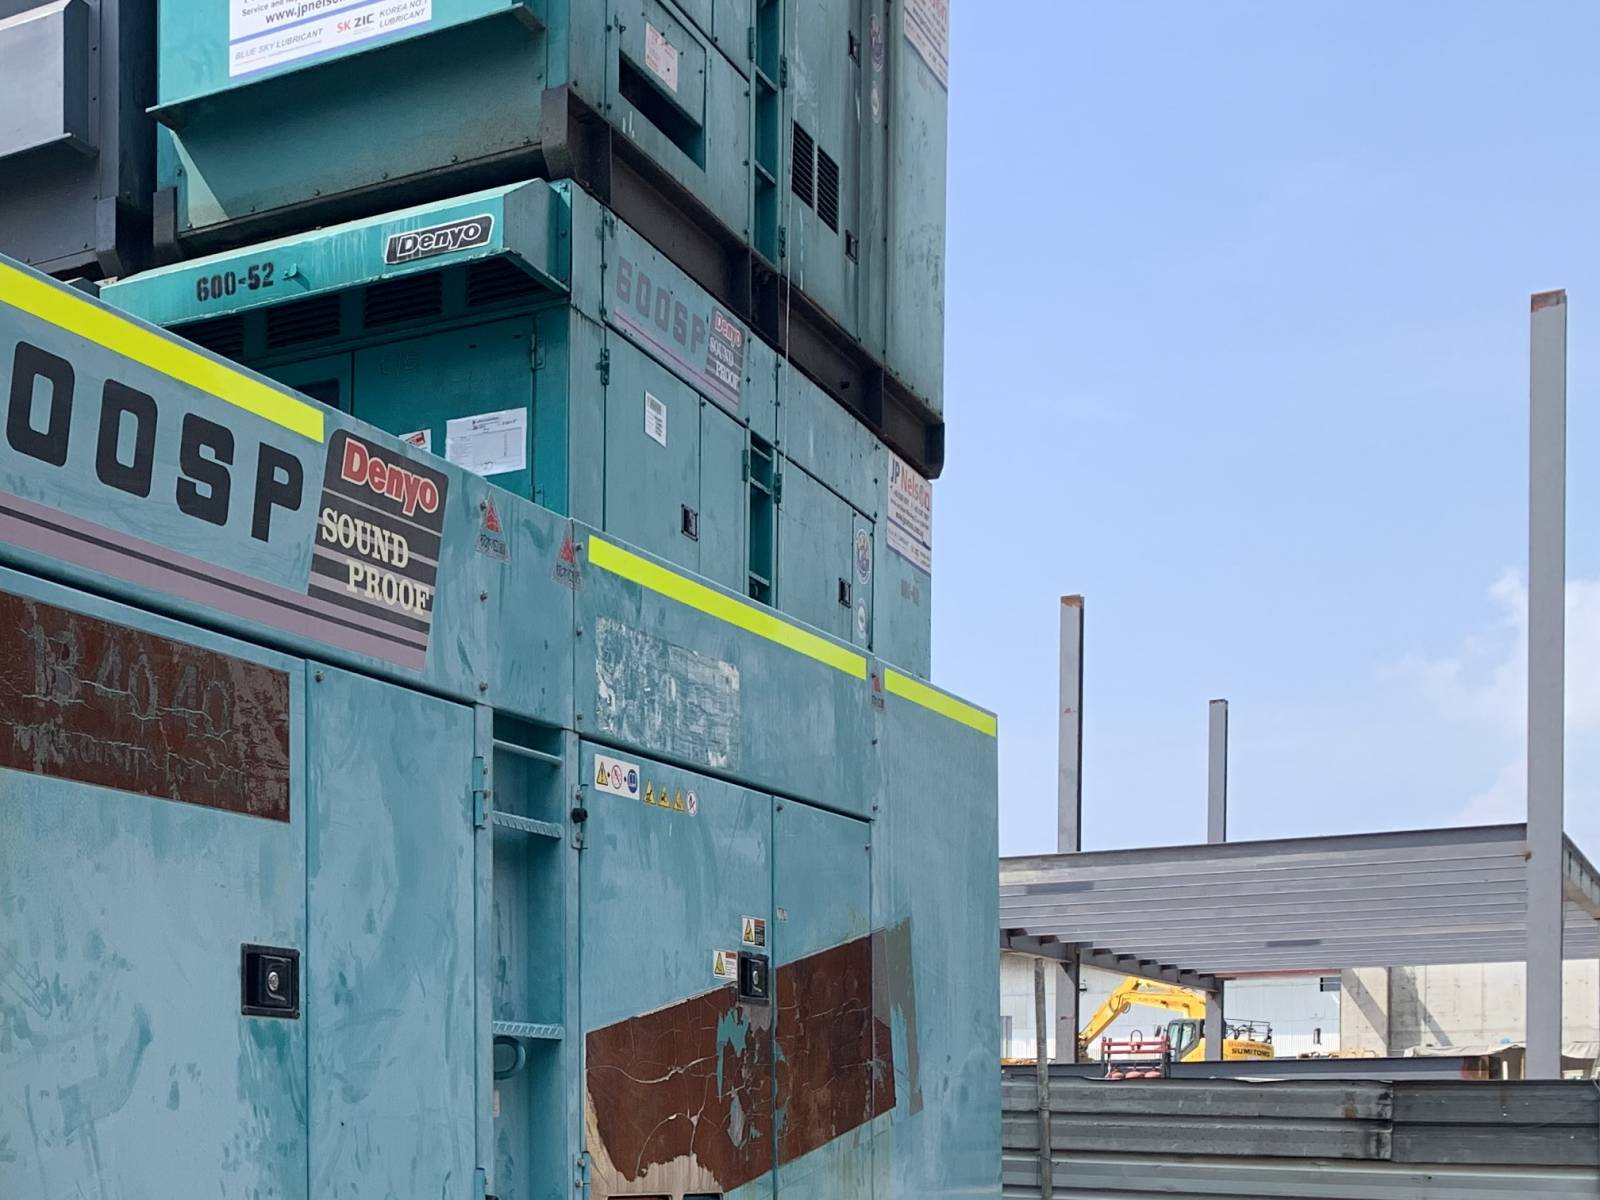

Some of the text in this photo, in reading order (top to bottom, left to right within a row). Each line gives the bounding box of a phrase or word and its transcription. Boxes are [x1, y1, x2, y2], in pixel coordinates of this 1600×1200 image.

[354, 13, 375, 28] ZIC
[397, 222, 483, 257] Denyo
[196, 262, 275, 303] 600-52
[341, 437, 439, 516] Denyo
[322, 507, 410, 569] SOUND
[345, 559, 430, 616] PROOF
